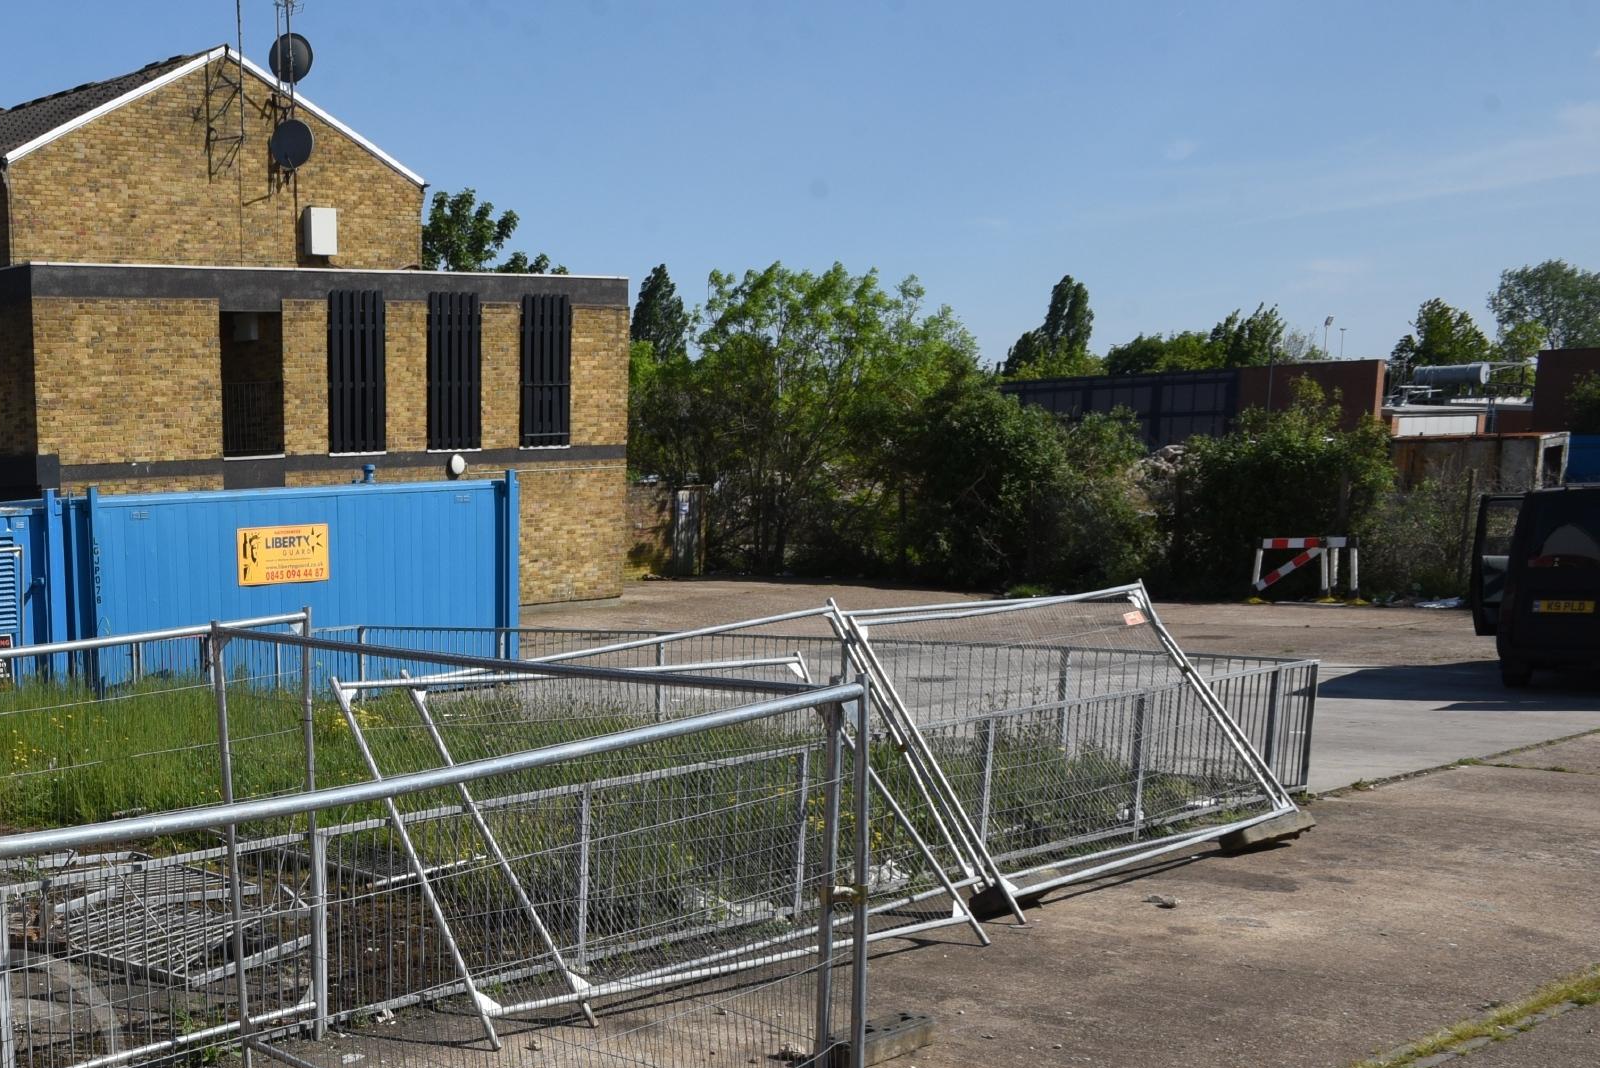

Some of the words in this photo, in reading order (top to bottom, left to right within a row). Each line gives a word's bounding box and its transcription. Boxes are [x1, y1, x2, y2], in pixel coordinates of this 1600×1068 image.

[265, 535, 310, 549] LIBERTY
[283, 548, 311, 557] GUARD
[266, 570, 284, 581] 0845
[286, 569, 301, 580] 094
[304, 568, 313, 578] 44
